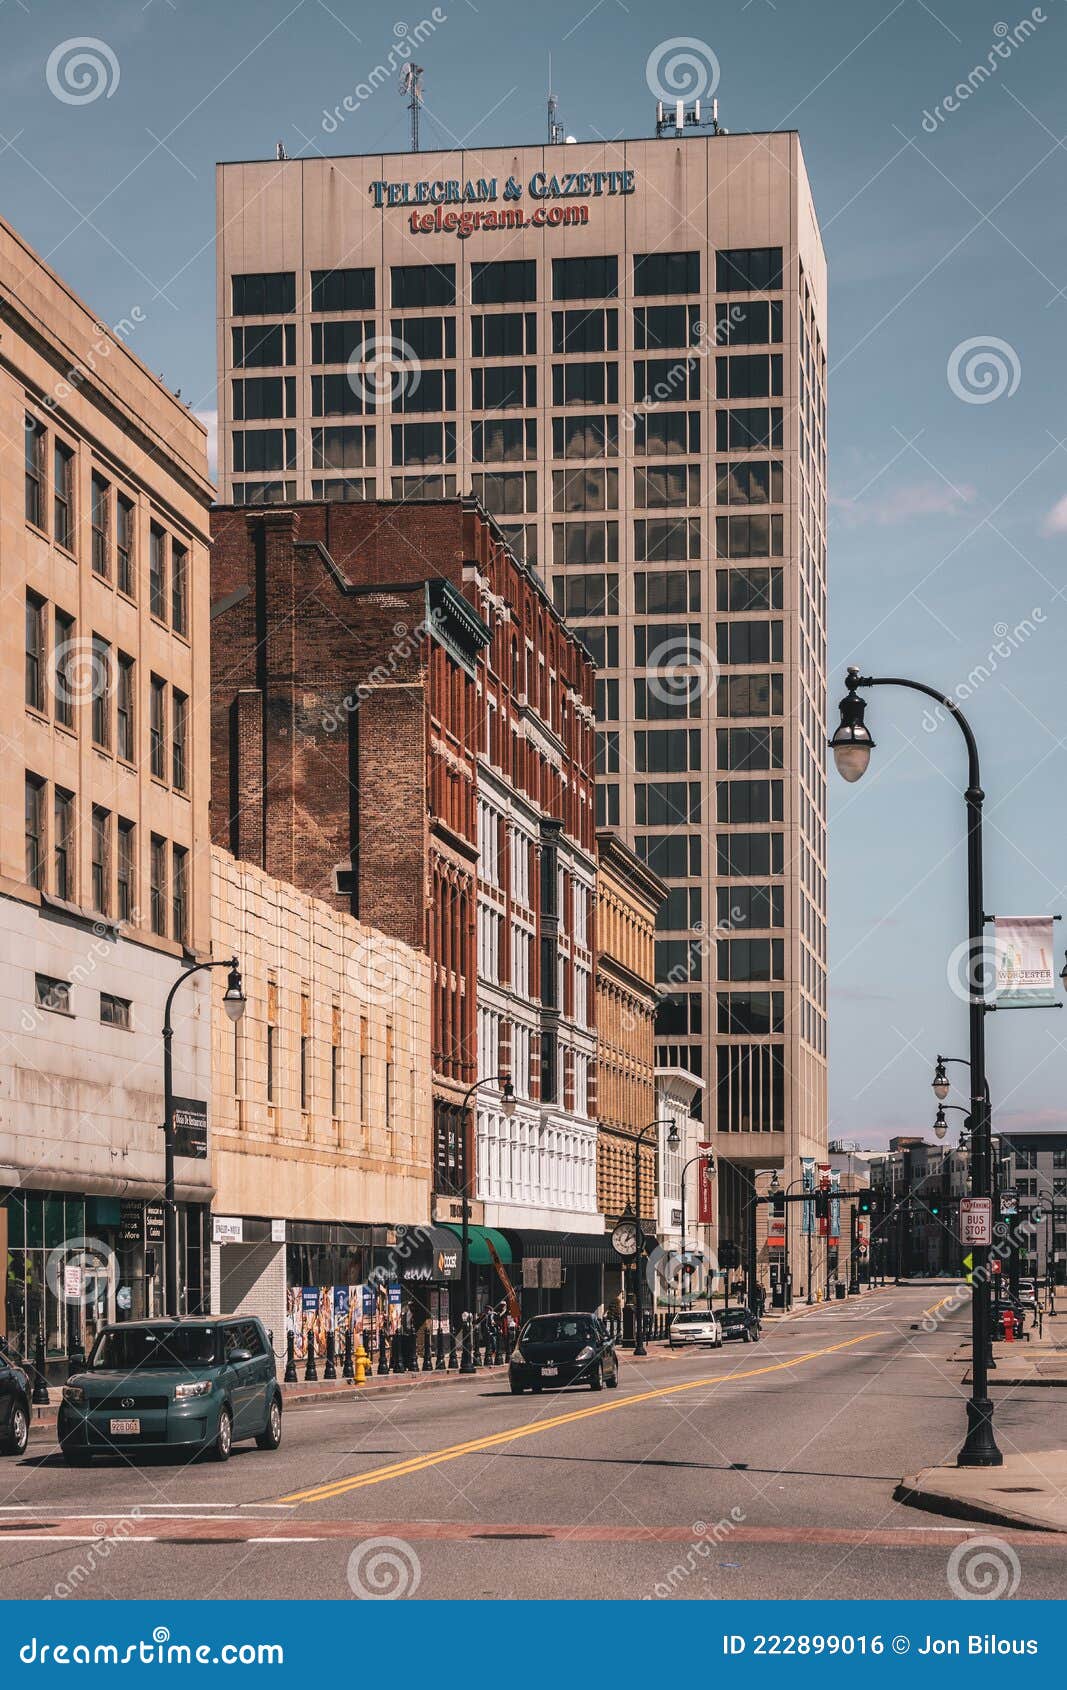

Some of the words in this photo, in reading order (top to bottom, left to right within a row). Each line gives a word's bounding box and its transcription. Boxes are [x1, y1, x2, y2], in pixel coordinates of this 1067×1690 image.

[369, 180, 498, 207] TELEGRAM
[503, 176, 522, 201] &
[529, 171, 637, 198] GAZETTE
[409, 204, 590, 239] telegram.com
[965, 1225, 986, 1236] STOP
[967, 1215, 984, 1225] BUS
